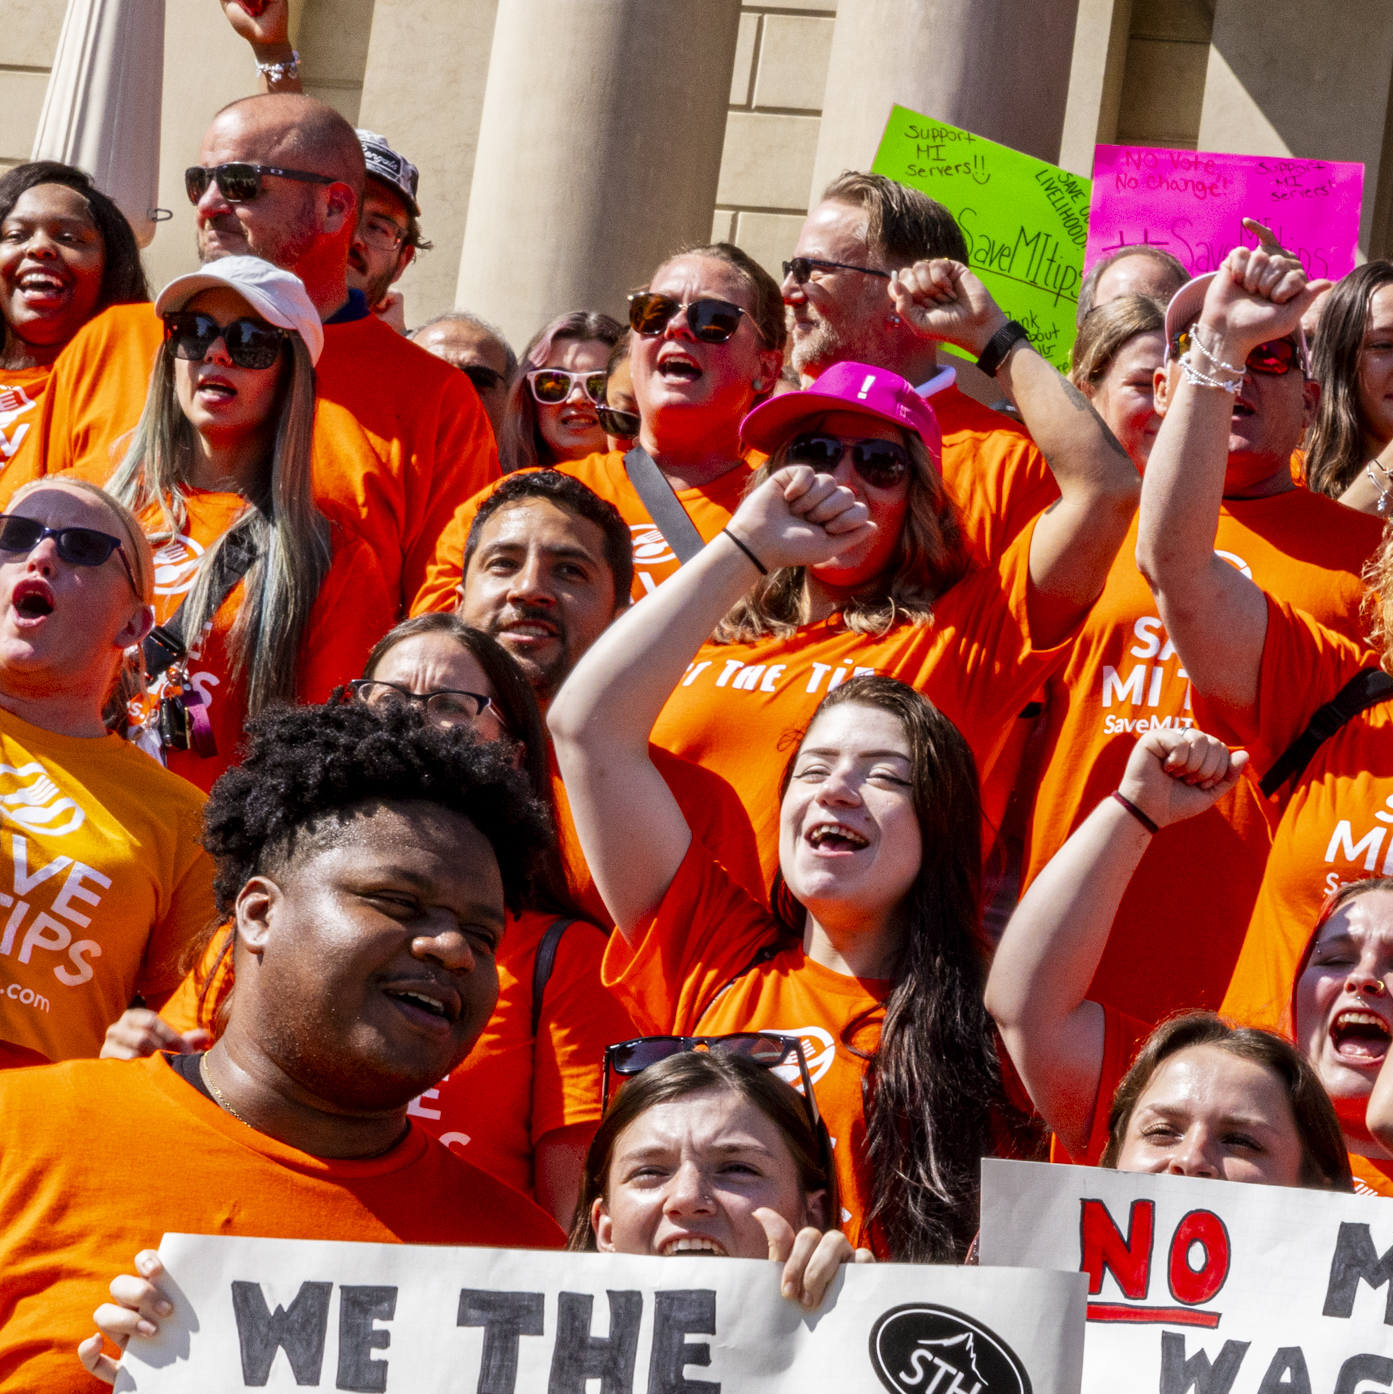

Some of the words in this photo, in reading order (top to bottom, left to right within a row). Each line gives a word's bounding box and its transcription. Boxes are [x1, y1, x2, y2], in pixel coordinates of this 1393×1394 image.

[904, 125, 977, 143] Support
[917, 144, 947, 161] MI
[715, 659, 787, 692] THE
[1102, 664, 1164, 708] MI
[1081, 1198, 1231, 1303] NO
[232, 1279, 398, 1394] WE
